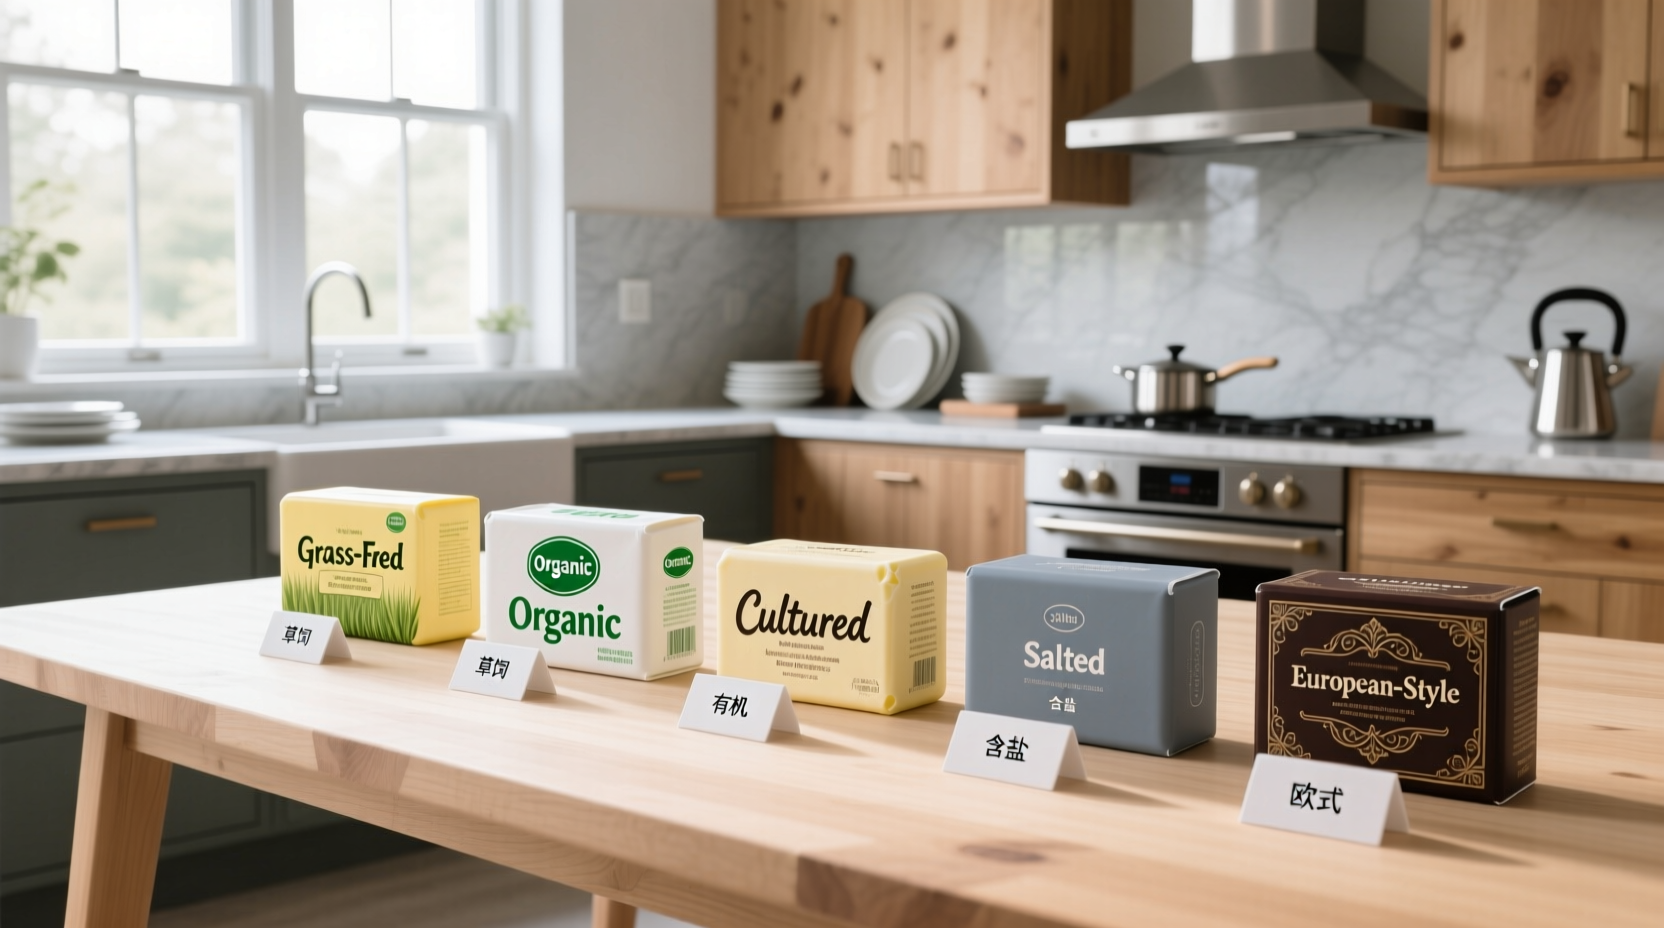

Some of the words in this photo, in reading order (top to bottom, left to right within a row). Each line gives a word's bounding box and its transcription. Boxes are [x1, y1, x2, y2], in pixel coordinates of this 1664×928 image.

[297, 535, 404, 570] Grass-Fred
[534, 555, 592, 579] Organic
[508, 596, 621, 645] Organic
[735, 588, 872, 643] Cultured
[1023, 640, 1105, 676] Salted
[1290, 664, 1460, 709] European-Style
[711, 692, 748, 718] 有机
[985, 733, 1029, 762] 含盐
[1290, 782, 1344, 814] 欧式
